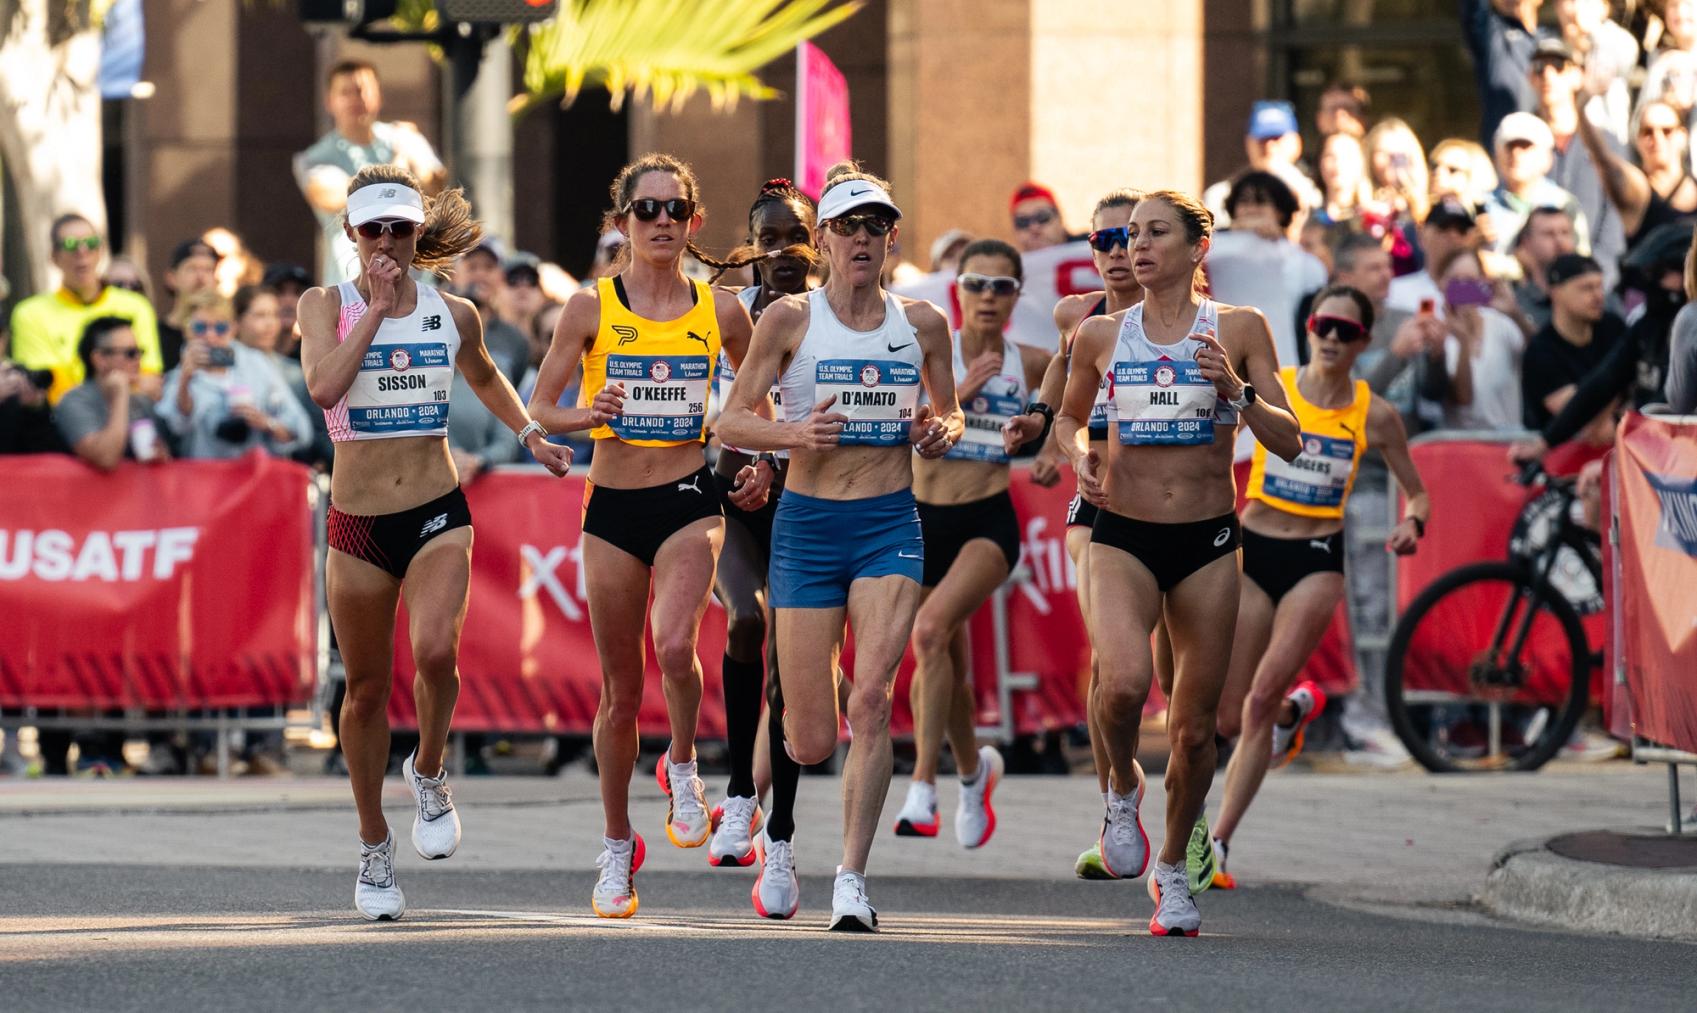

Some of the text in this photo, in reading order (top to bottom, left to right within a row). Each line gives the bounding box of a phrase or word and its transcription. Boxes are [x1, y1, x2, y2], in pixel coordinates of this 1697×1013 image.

[419, 349, 446, 357] MARATHON
[364, 359, 384, 367] TRIALS
[619, 361, 643, 369] OLYMPIC
[624, 368, 643, 376] TRIALS
[833, 373, 853, 381] TRIALS
[889, 368, 917, 376] MARATHON
[1185, 368, 1202, 376] MARA
[378, 374, 426, 391] SISSON
[1130, 374, 1148, 382] TRIALS
[433, 390, 447, 401] 103
[632, 386, 687, 401] O'KEEFFE
[842, 391, 896, 406] D'AMATO
[1149, 391, 1180, 406] HALL
[366, 405, 439, 420] ORLANDO 2024
[689, 402, 703, 413] 256
[899, 408, 912, 419] 104
[622, 416, 693, 427] ORLANDO 2024
[832, 421, 902, 433] LANDO 2024
[1131, 421, 1200, 432] ORLANDO 2024
[0, 526, 199, 581] USATF
